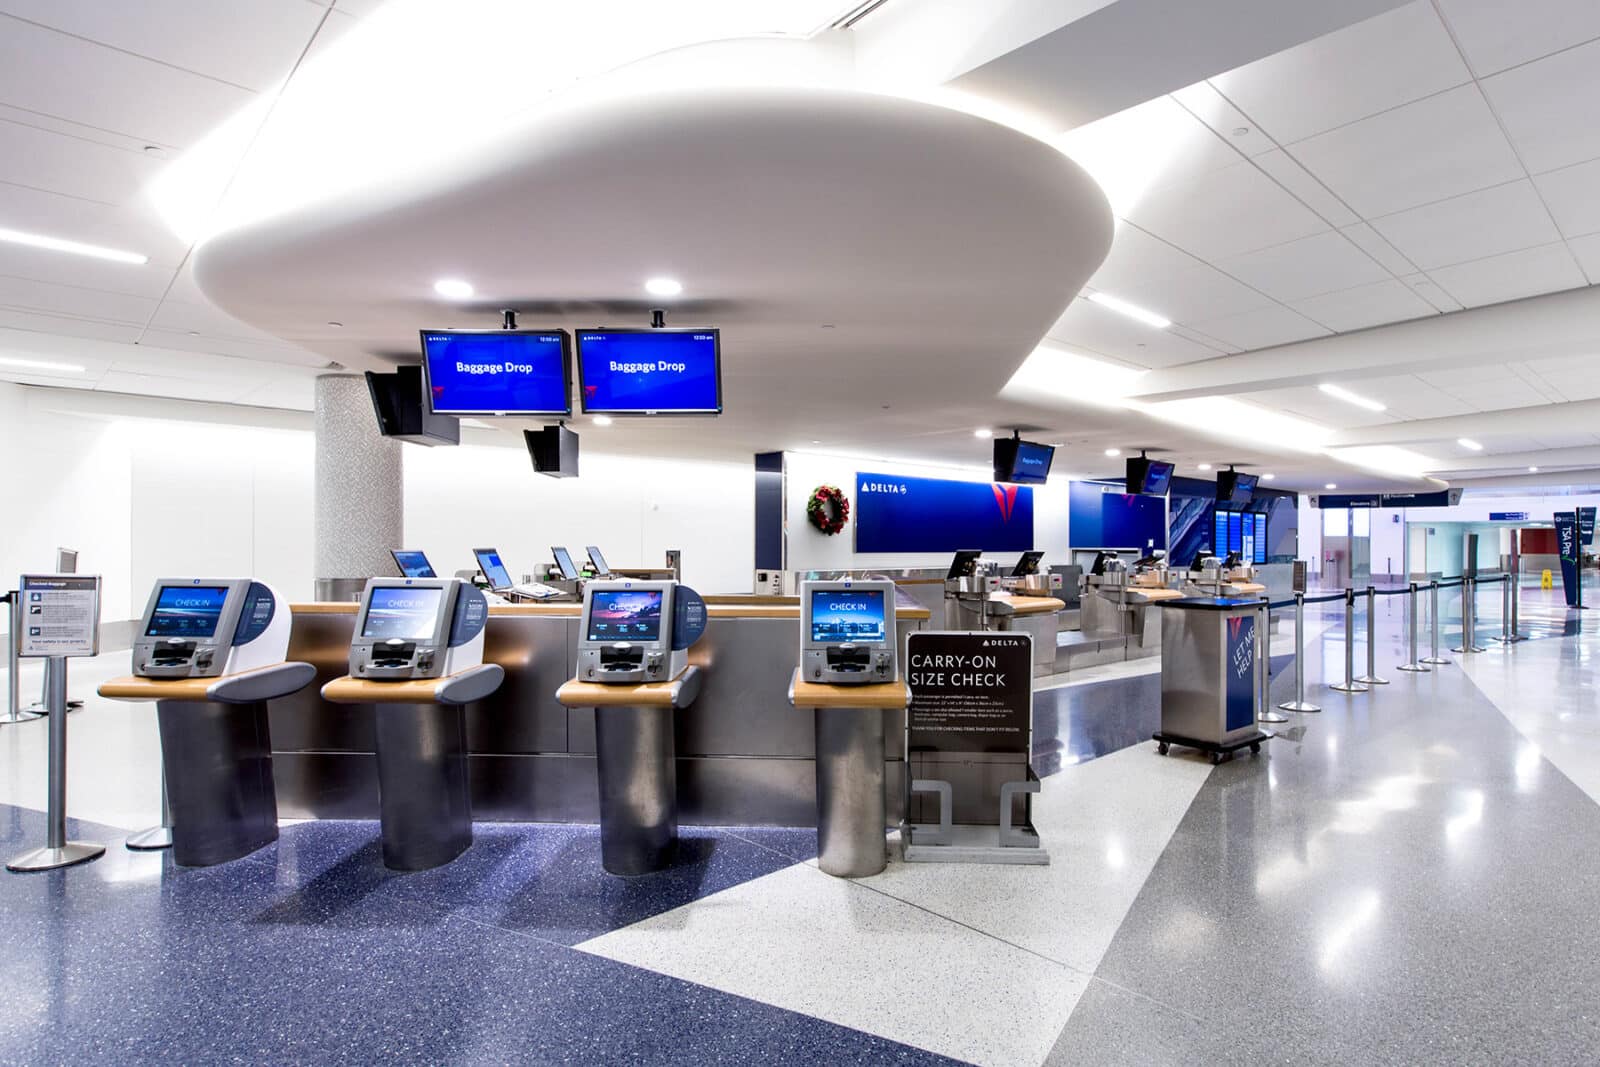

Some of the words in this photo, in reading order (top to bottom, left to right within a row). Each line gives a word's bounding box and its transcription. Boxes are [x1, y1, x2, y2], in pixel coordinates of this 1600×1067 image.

[456, 361, 503, 374] Baggage
[505, 362, 533, 374] Drop
[609, 361, 656, 374] Baggage
[658, 360, 686, 374] Drop
[870, 483, 899, 494] DELTA
[1561, 526, 1573, 541] TSA
[1561, 541, 1573, 555] Pre
[175, 599, 201, 607] CHECK
[202, 599, 211, 607] IN
[388, 599, 414, 608] CHECK
[829, 602, 857, 611] CHECK
[857, 603, 867, 611] IN
[1233, 643, 1245, 666] LET
[1244, 625, 1255, 647] ME
[911, 654, 996, 668] CARRY-ON
[1236, 651, 1253, 679] HELP
[911, 672, 945, 686] SIZE
[951, 673, 1006, 687] CHECK
